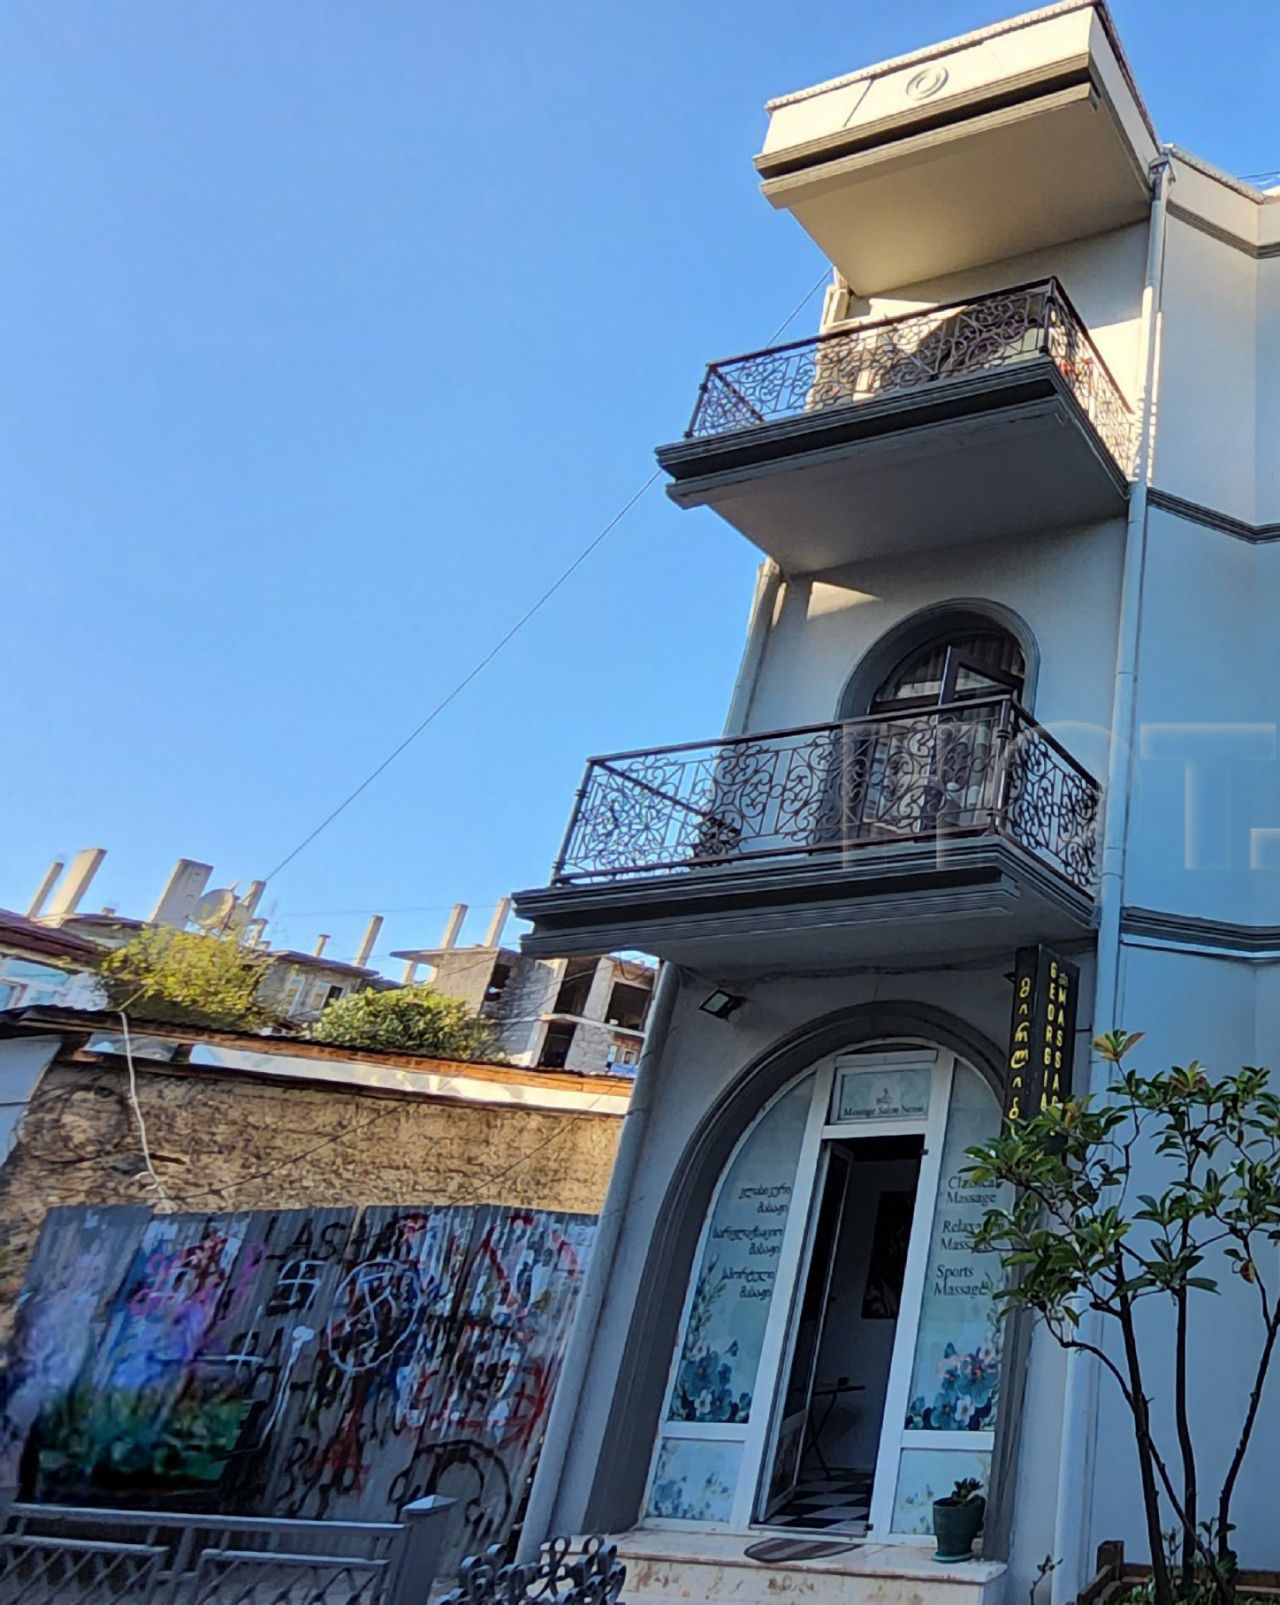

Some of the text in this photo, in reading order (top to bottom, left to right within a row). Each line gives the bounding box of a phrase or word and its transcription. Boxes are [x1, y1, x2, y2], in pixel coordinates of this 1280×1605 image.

[1049, 986, 1067, 1135] MASSA
[946, 1191, 997, 1207] Massage
[937, 1264, 975, 1281] Sports
[934, 1282, 988, 1300] Massage
